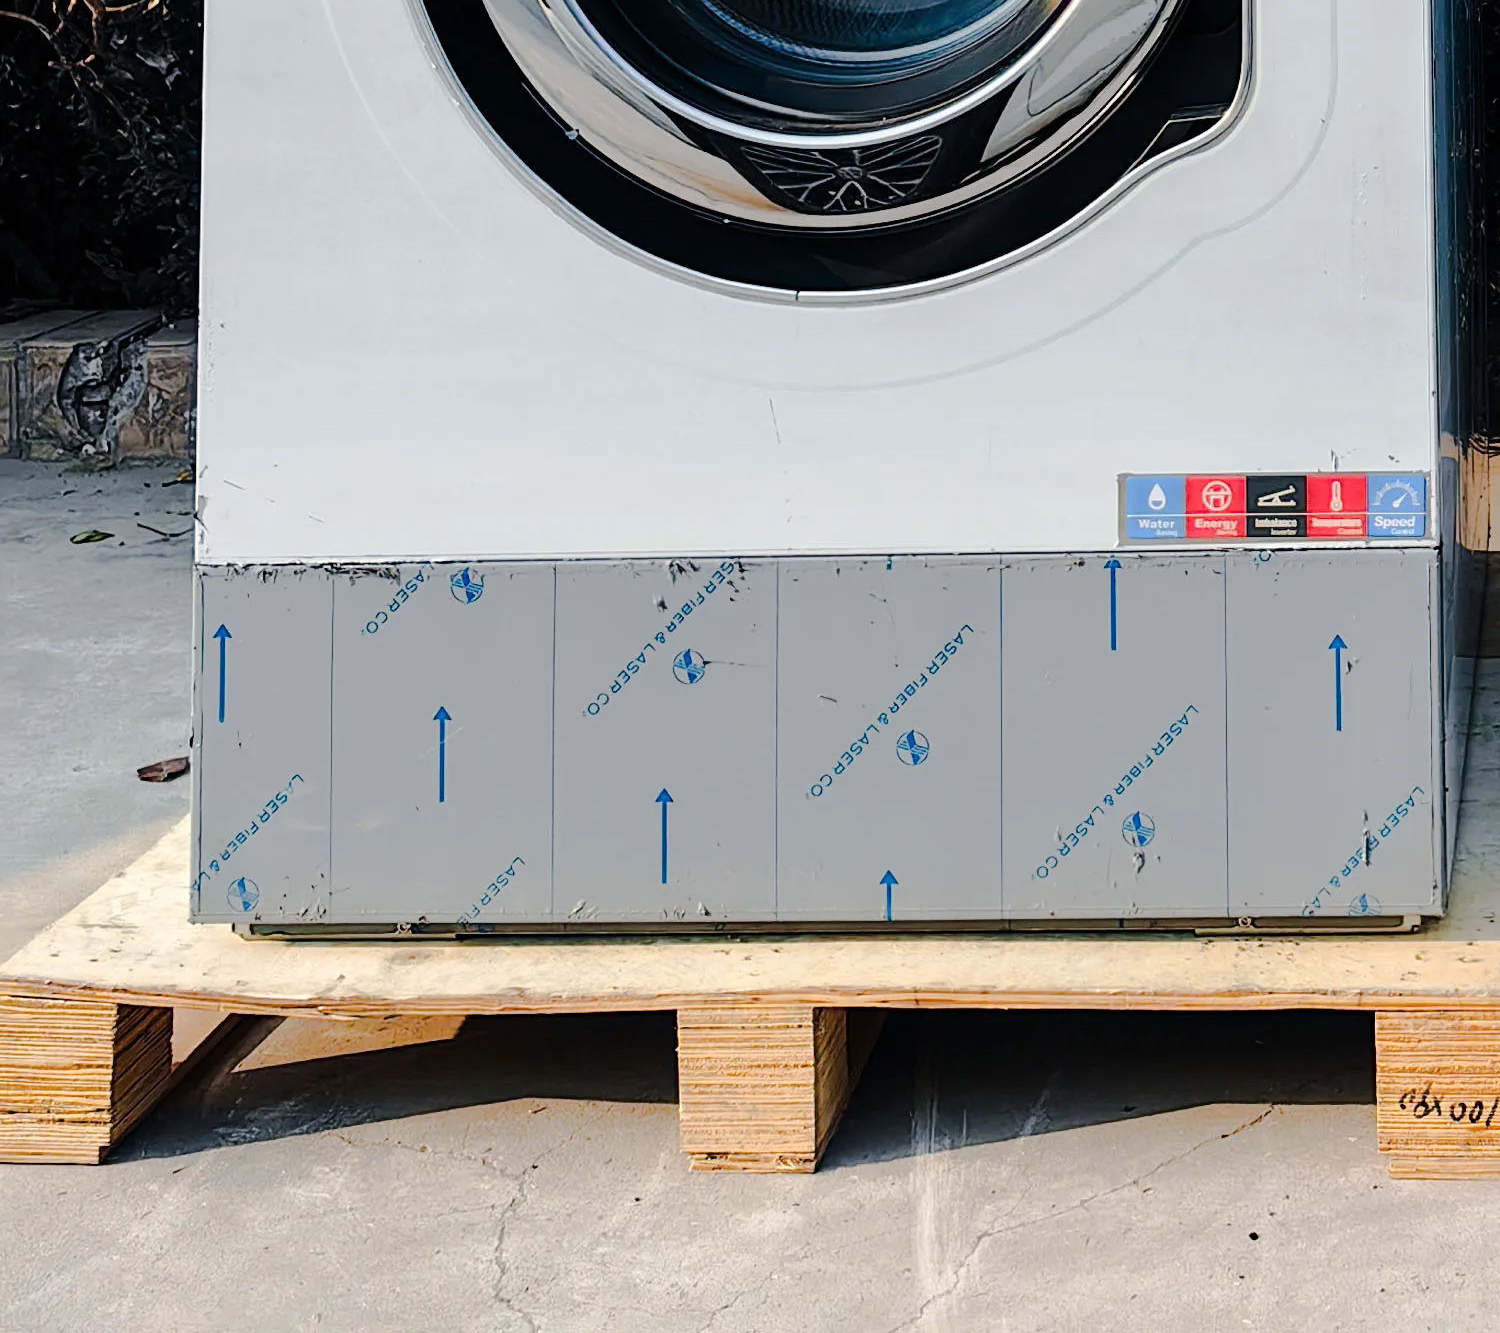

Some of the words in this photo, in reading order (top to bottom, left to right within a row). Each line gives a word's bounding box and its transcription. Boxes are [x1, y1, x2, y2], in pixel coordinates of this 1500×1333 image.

[1138, 518, 1176, 530] Water
[1194, 517, 1239, 532] Energy
[1373, 515, 1417, 531] Speed
[664, 590, 706, 634] FIBER
[653, 631, 667, 645] &
[925, 623, 975, 676] LASER
[608, 642, 657, 695] LASER
[887, 672, 929, 715] FIBER
[876, 711, 890, 726] &
[1150, 703, 1200, 757] LASER
[832, 723, 881, 776] LASER
[1112, 753, 1155, 797] FIBER
[1102, 793, 1116, 807] &
[1377, 785, 1426, 839] LASER
[219, 820, 260, 862] FIBER
[1056, 804, 1106, 858] LASER
[479, 856, 526, 906] LASER
